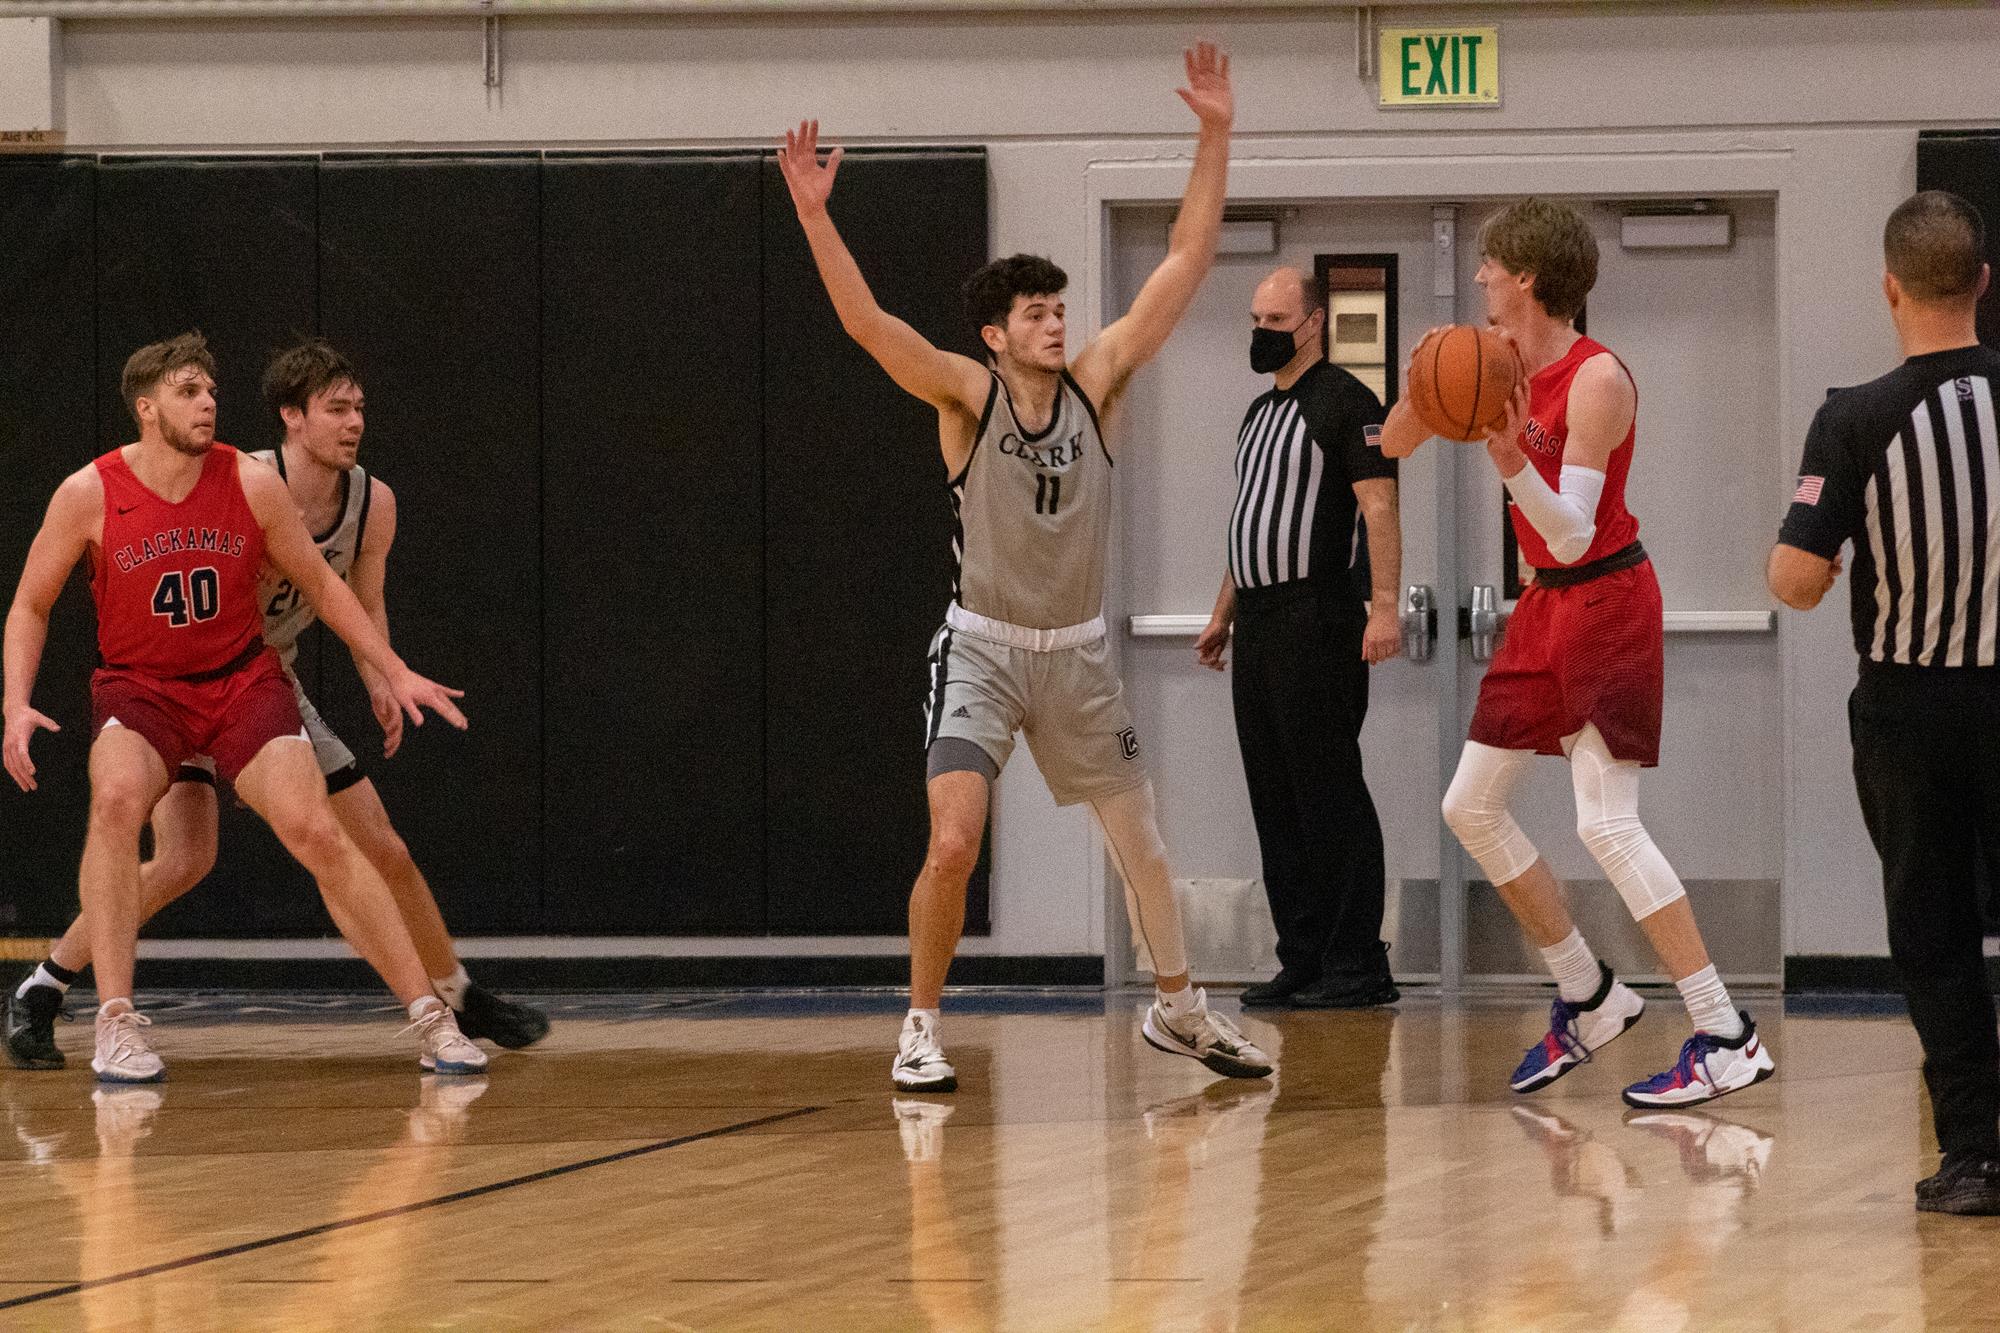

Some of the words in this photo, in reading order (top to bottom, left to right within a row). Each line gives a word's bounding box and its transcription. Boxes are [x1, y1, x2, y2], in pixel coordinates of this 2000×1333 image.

[1401, 36, 1482, 95] EXIT
[999, 431, 1083, 468] CLARK
[1036, 473, 1060, 514] 11
[114, 528, 246, 573] CLACKAMAS
[152, 566, 220, 628] 40
